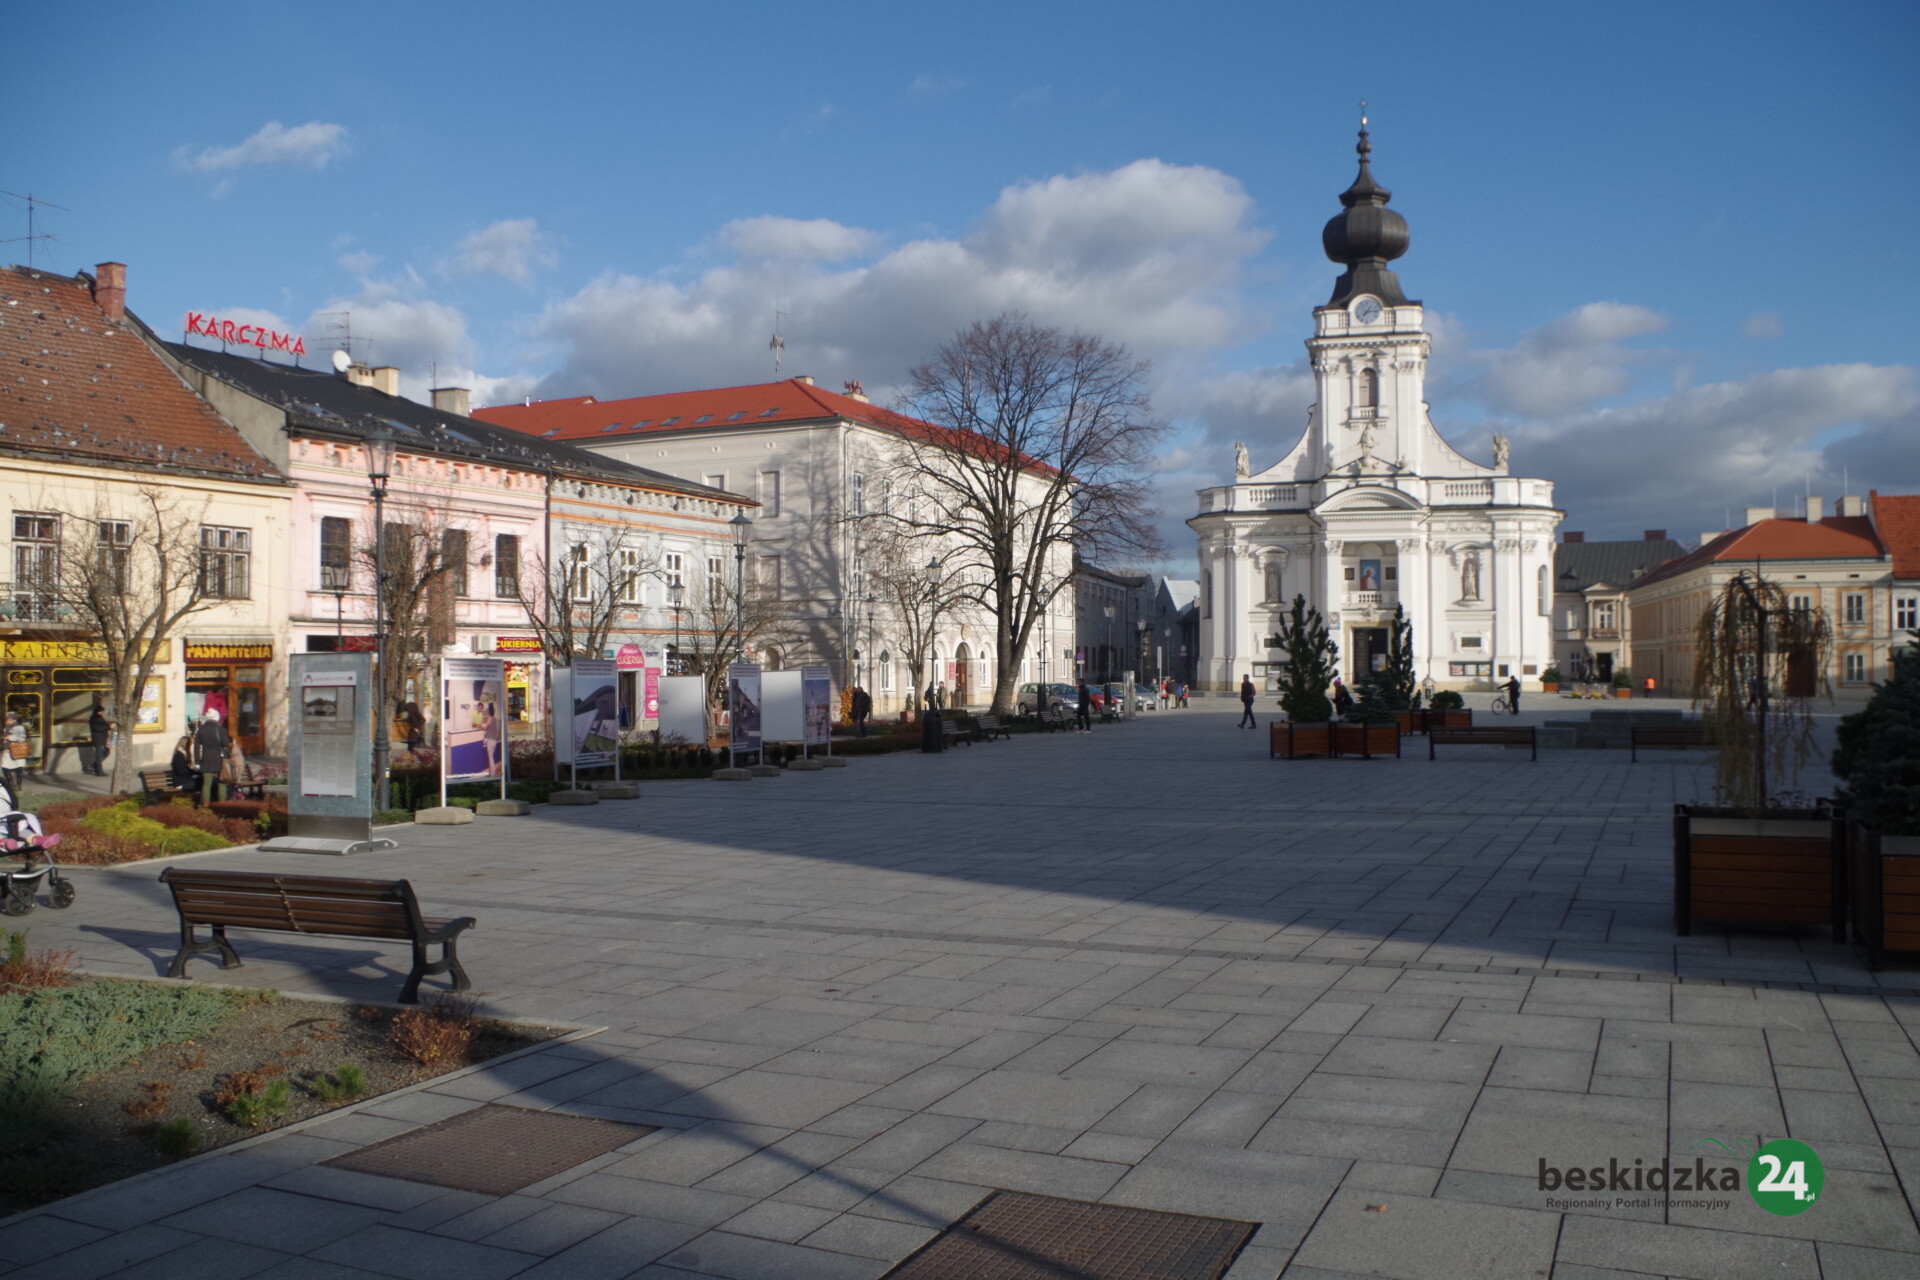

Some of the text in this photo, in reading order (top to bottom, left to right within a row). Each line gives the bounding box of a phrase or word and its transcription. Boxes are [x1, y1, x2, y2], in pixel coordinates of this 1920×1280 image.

[187, 312, 305, 355] KARCZMA
[496, 640, 541, 649] CUKIERNIA
[186, 646, 271, 659] PASMANTERIA
